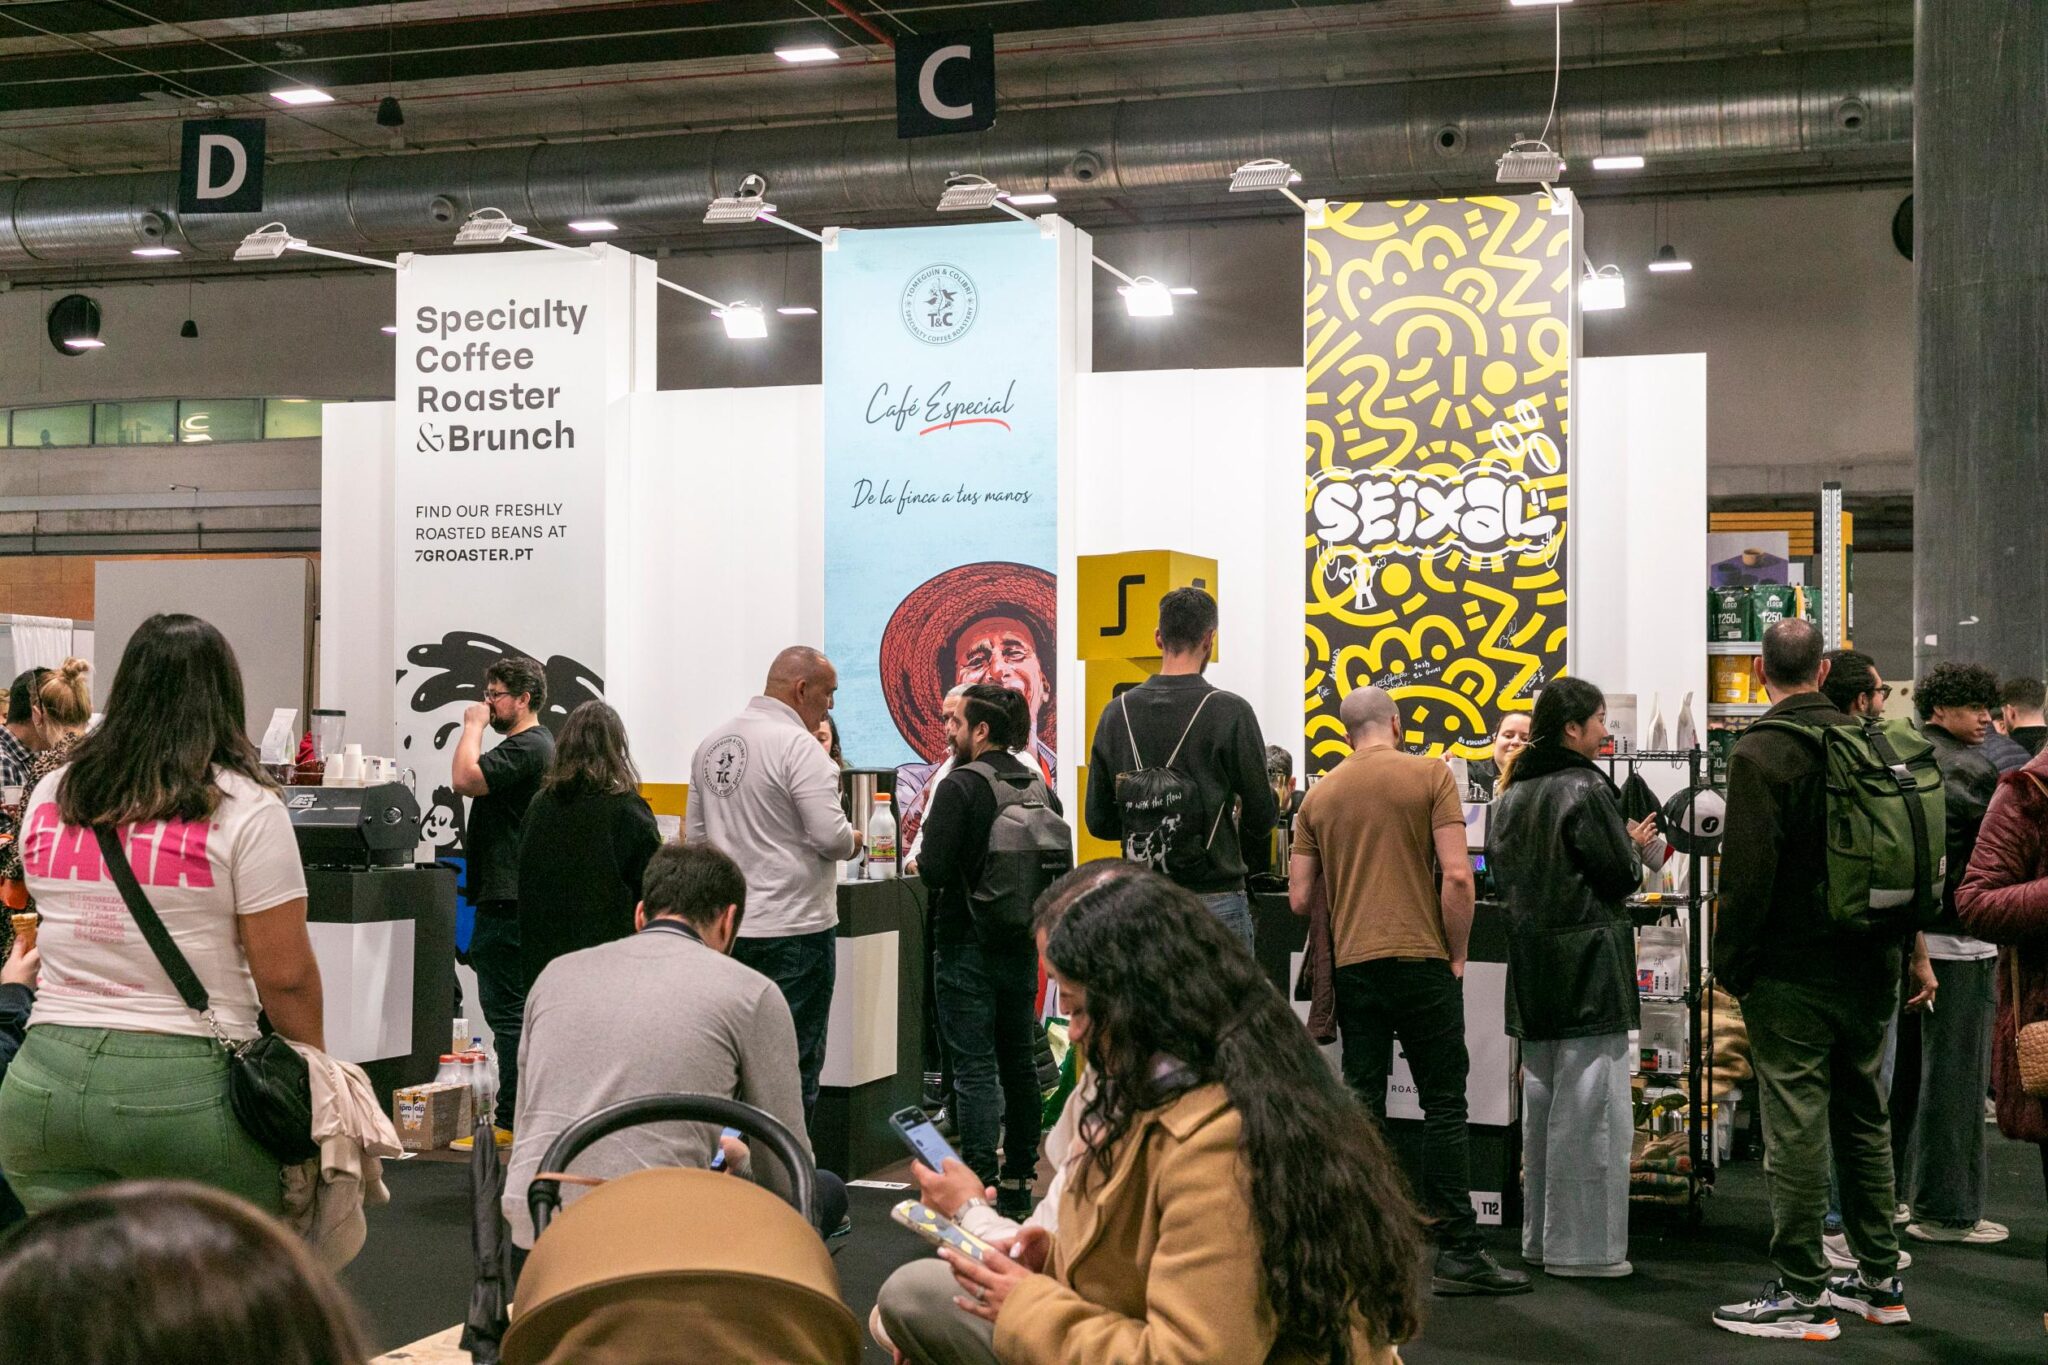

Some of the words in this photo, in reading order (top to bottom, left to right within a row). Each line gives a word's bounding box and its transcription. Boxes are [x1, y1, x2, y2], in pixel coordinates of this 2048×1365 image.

[918, 44, 973, 119] C
[197, 134, 247, 199] D
[416, 299, 588, 340] Specialty
[928, 312, 952, 328] T&C
[416, 342, 534, 374] Coffee
[417, 383, 560, 412] Roaster
[866, 382, 920, 432] Café
[925, 379, 1016, 430] Especial
[416, 505, 452, 518] FIND
[456, 504, 490, 518] OUR
[495, 503, 563, 516] FRESHLY
[852, 478, 876, 508] De
[879, 480, 896, 505] la
[896, 480, 940, 515] finca
[942, 492, 954, 504] a
[957, 483, 981, 505] tus
[984, 490, 1032, 504] manos
[416, 526, 486, 540] ROASTED
[490, 526, 543, 539] BEANS
[548, 526, 567, 538] AT
[414, 548, 534, 562] 7GROASTER.PT
[1152, 796, 1163, 808] the
[1166, 792, 1182, 807] flow
[1482, 1201, 1500, 1215] T12
